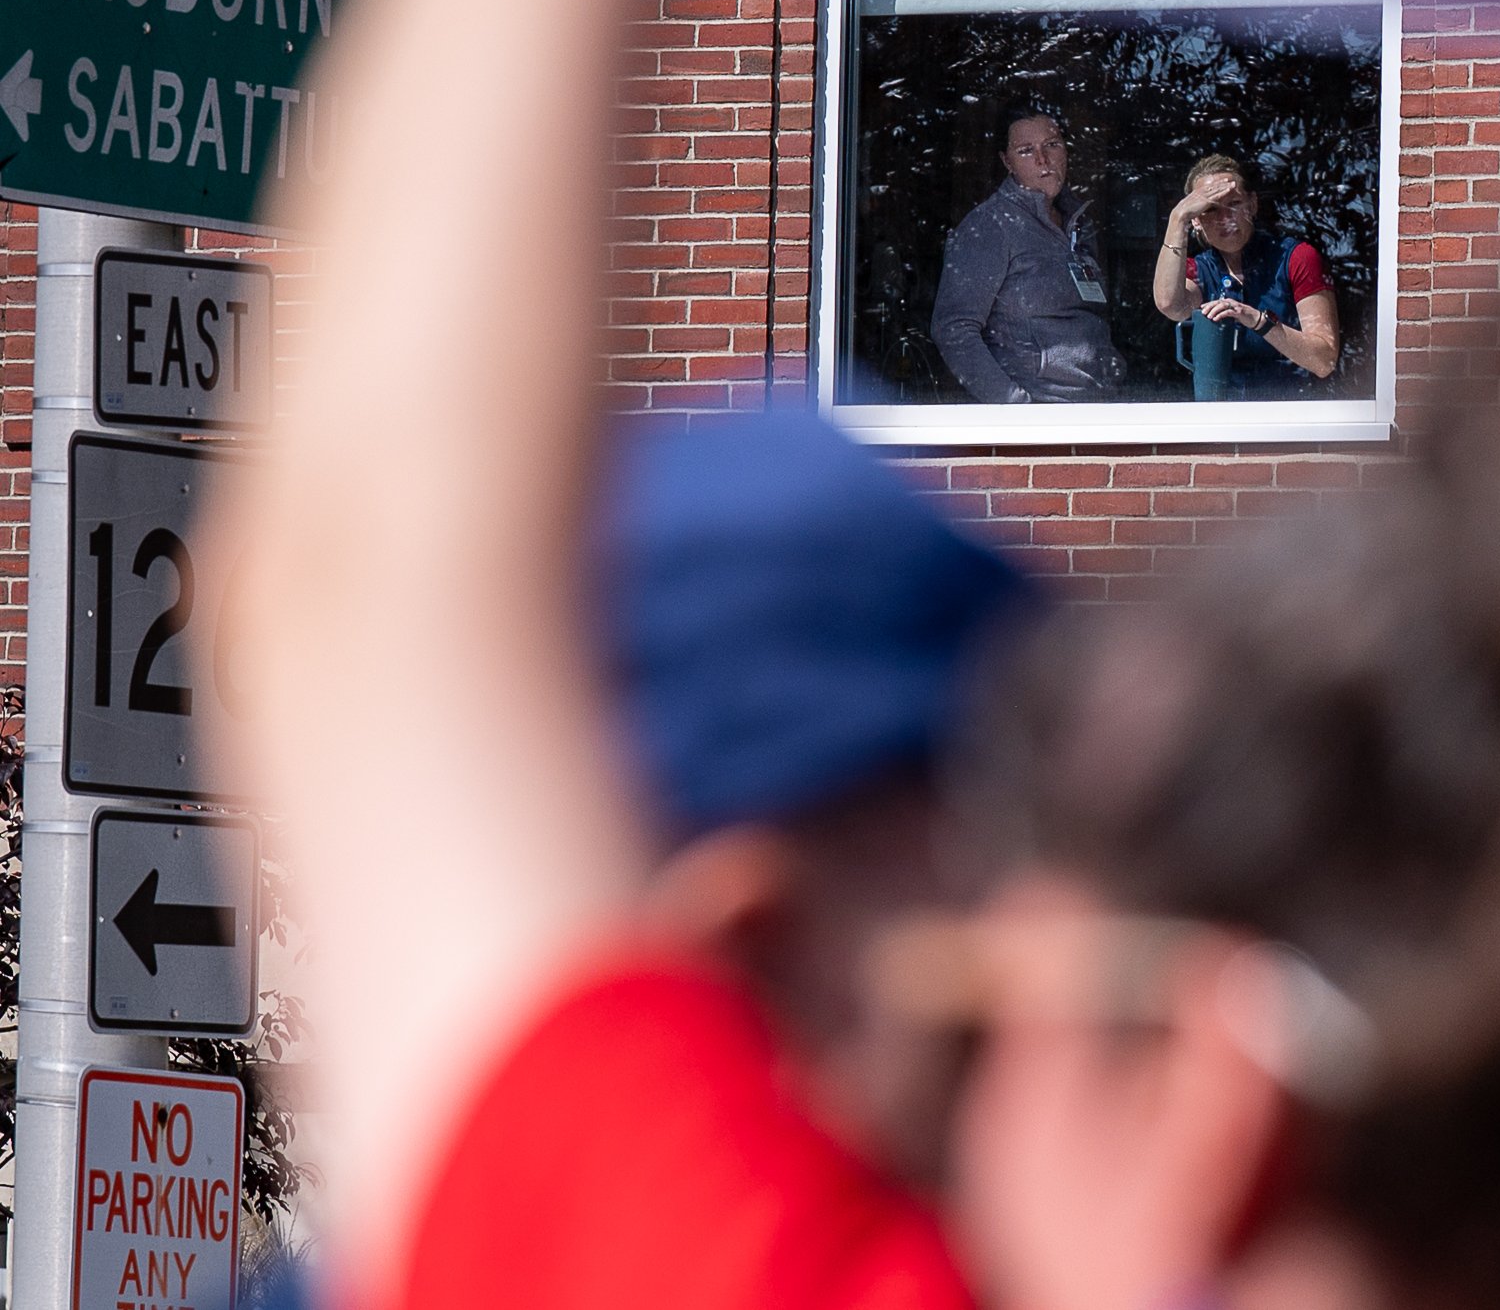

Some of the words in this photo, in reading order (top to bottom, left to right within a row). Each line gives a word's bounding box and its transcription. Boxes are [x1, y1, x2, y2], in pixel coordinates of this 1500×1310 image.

[63, 56, 342, 184] SABATTU
[126, 292, 249, 392] EAST
[131, 1100, 193, 1166] NO
[86, 1168, 230, 1242] PARKING
[118, 1248, 197, 1300] ANY
